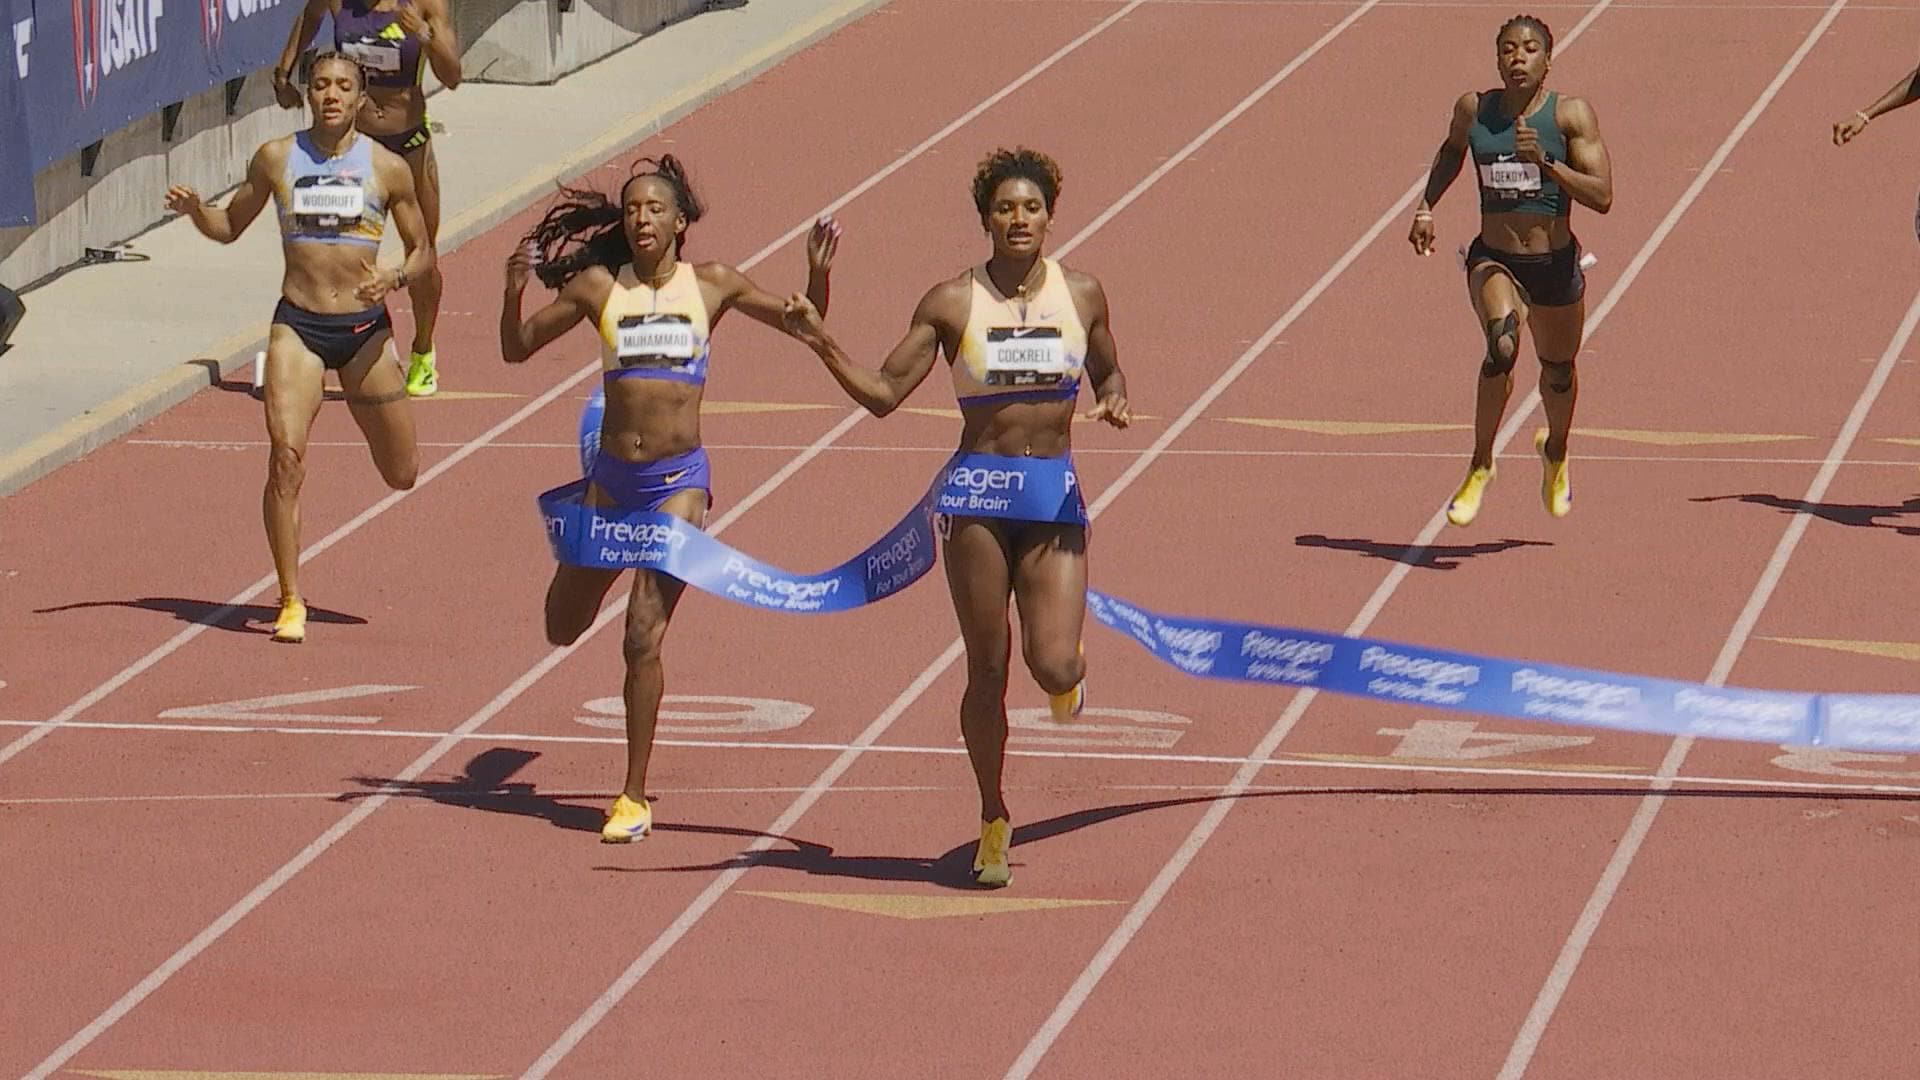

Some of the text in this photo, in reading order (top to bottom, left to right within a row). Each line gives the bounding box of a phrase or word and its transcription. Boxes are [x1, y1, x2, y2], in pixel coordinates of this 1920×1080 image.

[302, 193, 355, 208] WOODRUFF
[623, 332, 688, 348] MUHAMMAD
[997, 347, 1051, 363] COCKRELL
[968, 495, 1009, 511] Brain
[590, 515, 686, 549] Prevagen
[867, 527, 921, 580] Prevagen
[722, 557, 839, 600] Prevagen
